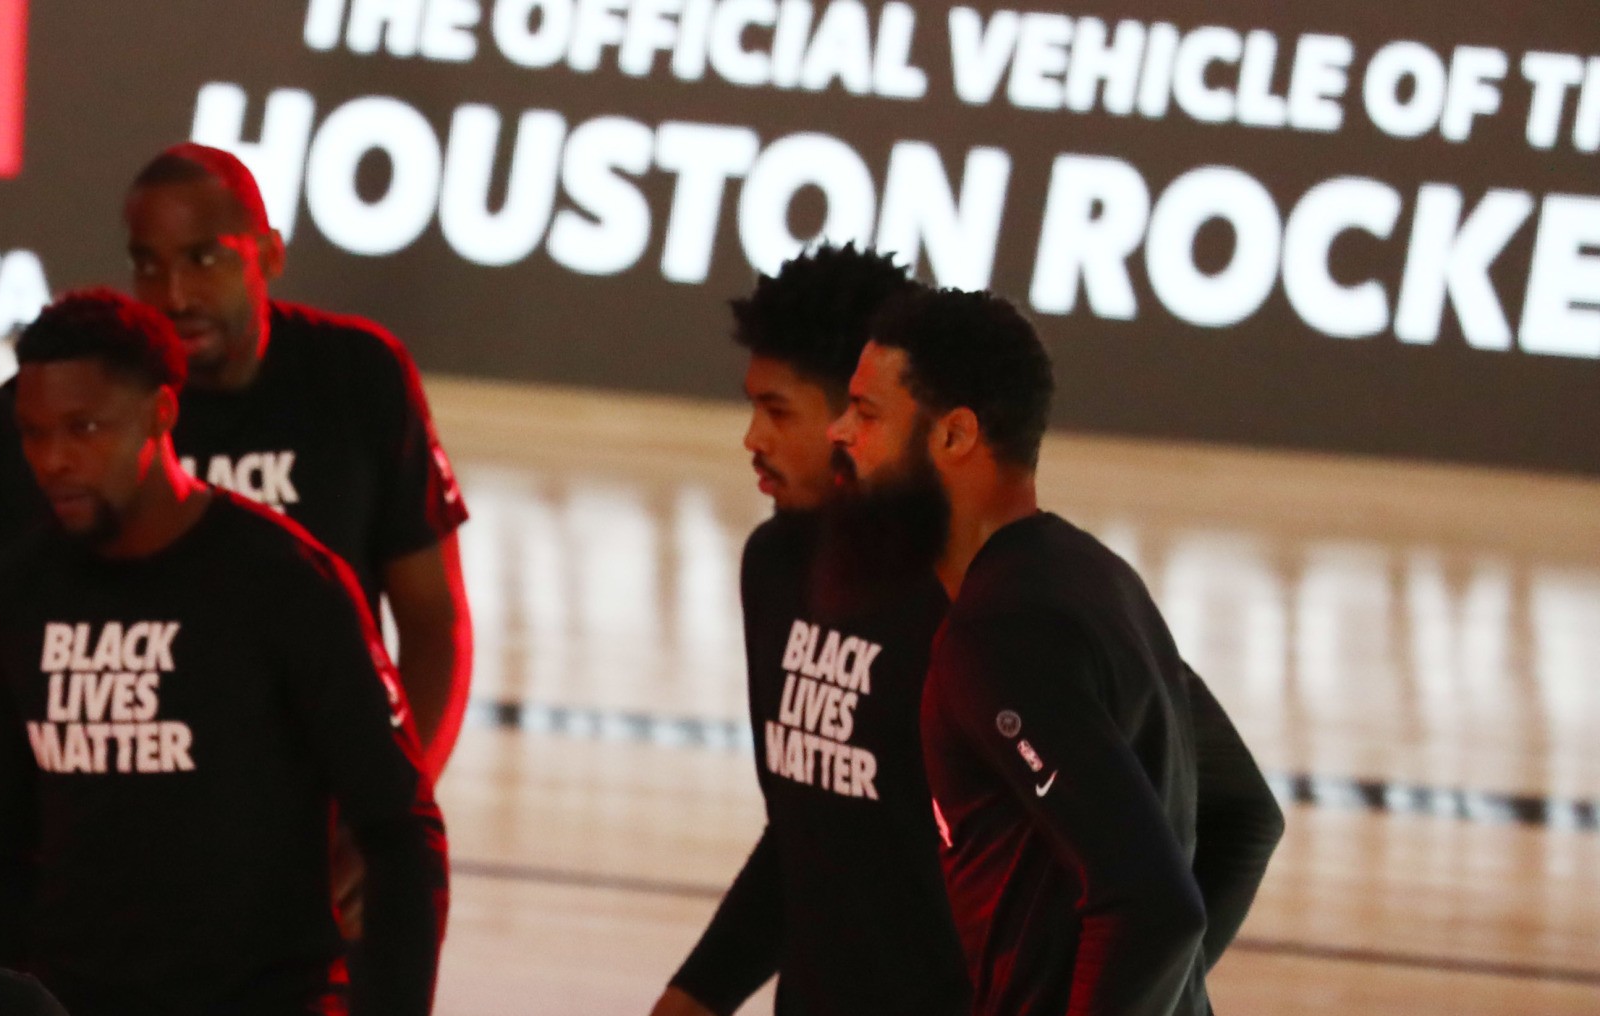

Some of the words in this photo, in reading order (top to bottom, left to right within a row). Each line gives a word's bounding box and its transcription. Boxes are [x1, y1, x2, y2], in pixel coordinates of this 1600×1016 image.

[492, 0, 927, 99] OFFICIAL
[948, 5, 1354, 132] VEHICLE
[1362, 41, 1509, 143] OF
[190, 81, 1012, 293] HOUSTON
[179, 450, 299, 503] ACK
[40, 621, 181, 672] BLACK
[781, 618, 883, 695] BLACK
[47, 672, 160, 722] LIVES
[779, 672, 859, 742] LIVES
[26, 720, 196, 774] MATTER
[765, 719, 880, 801] MATTER
